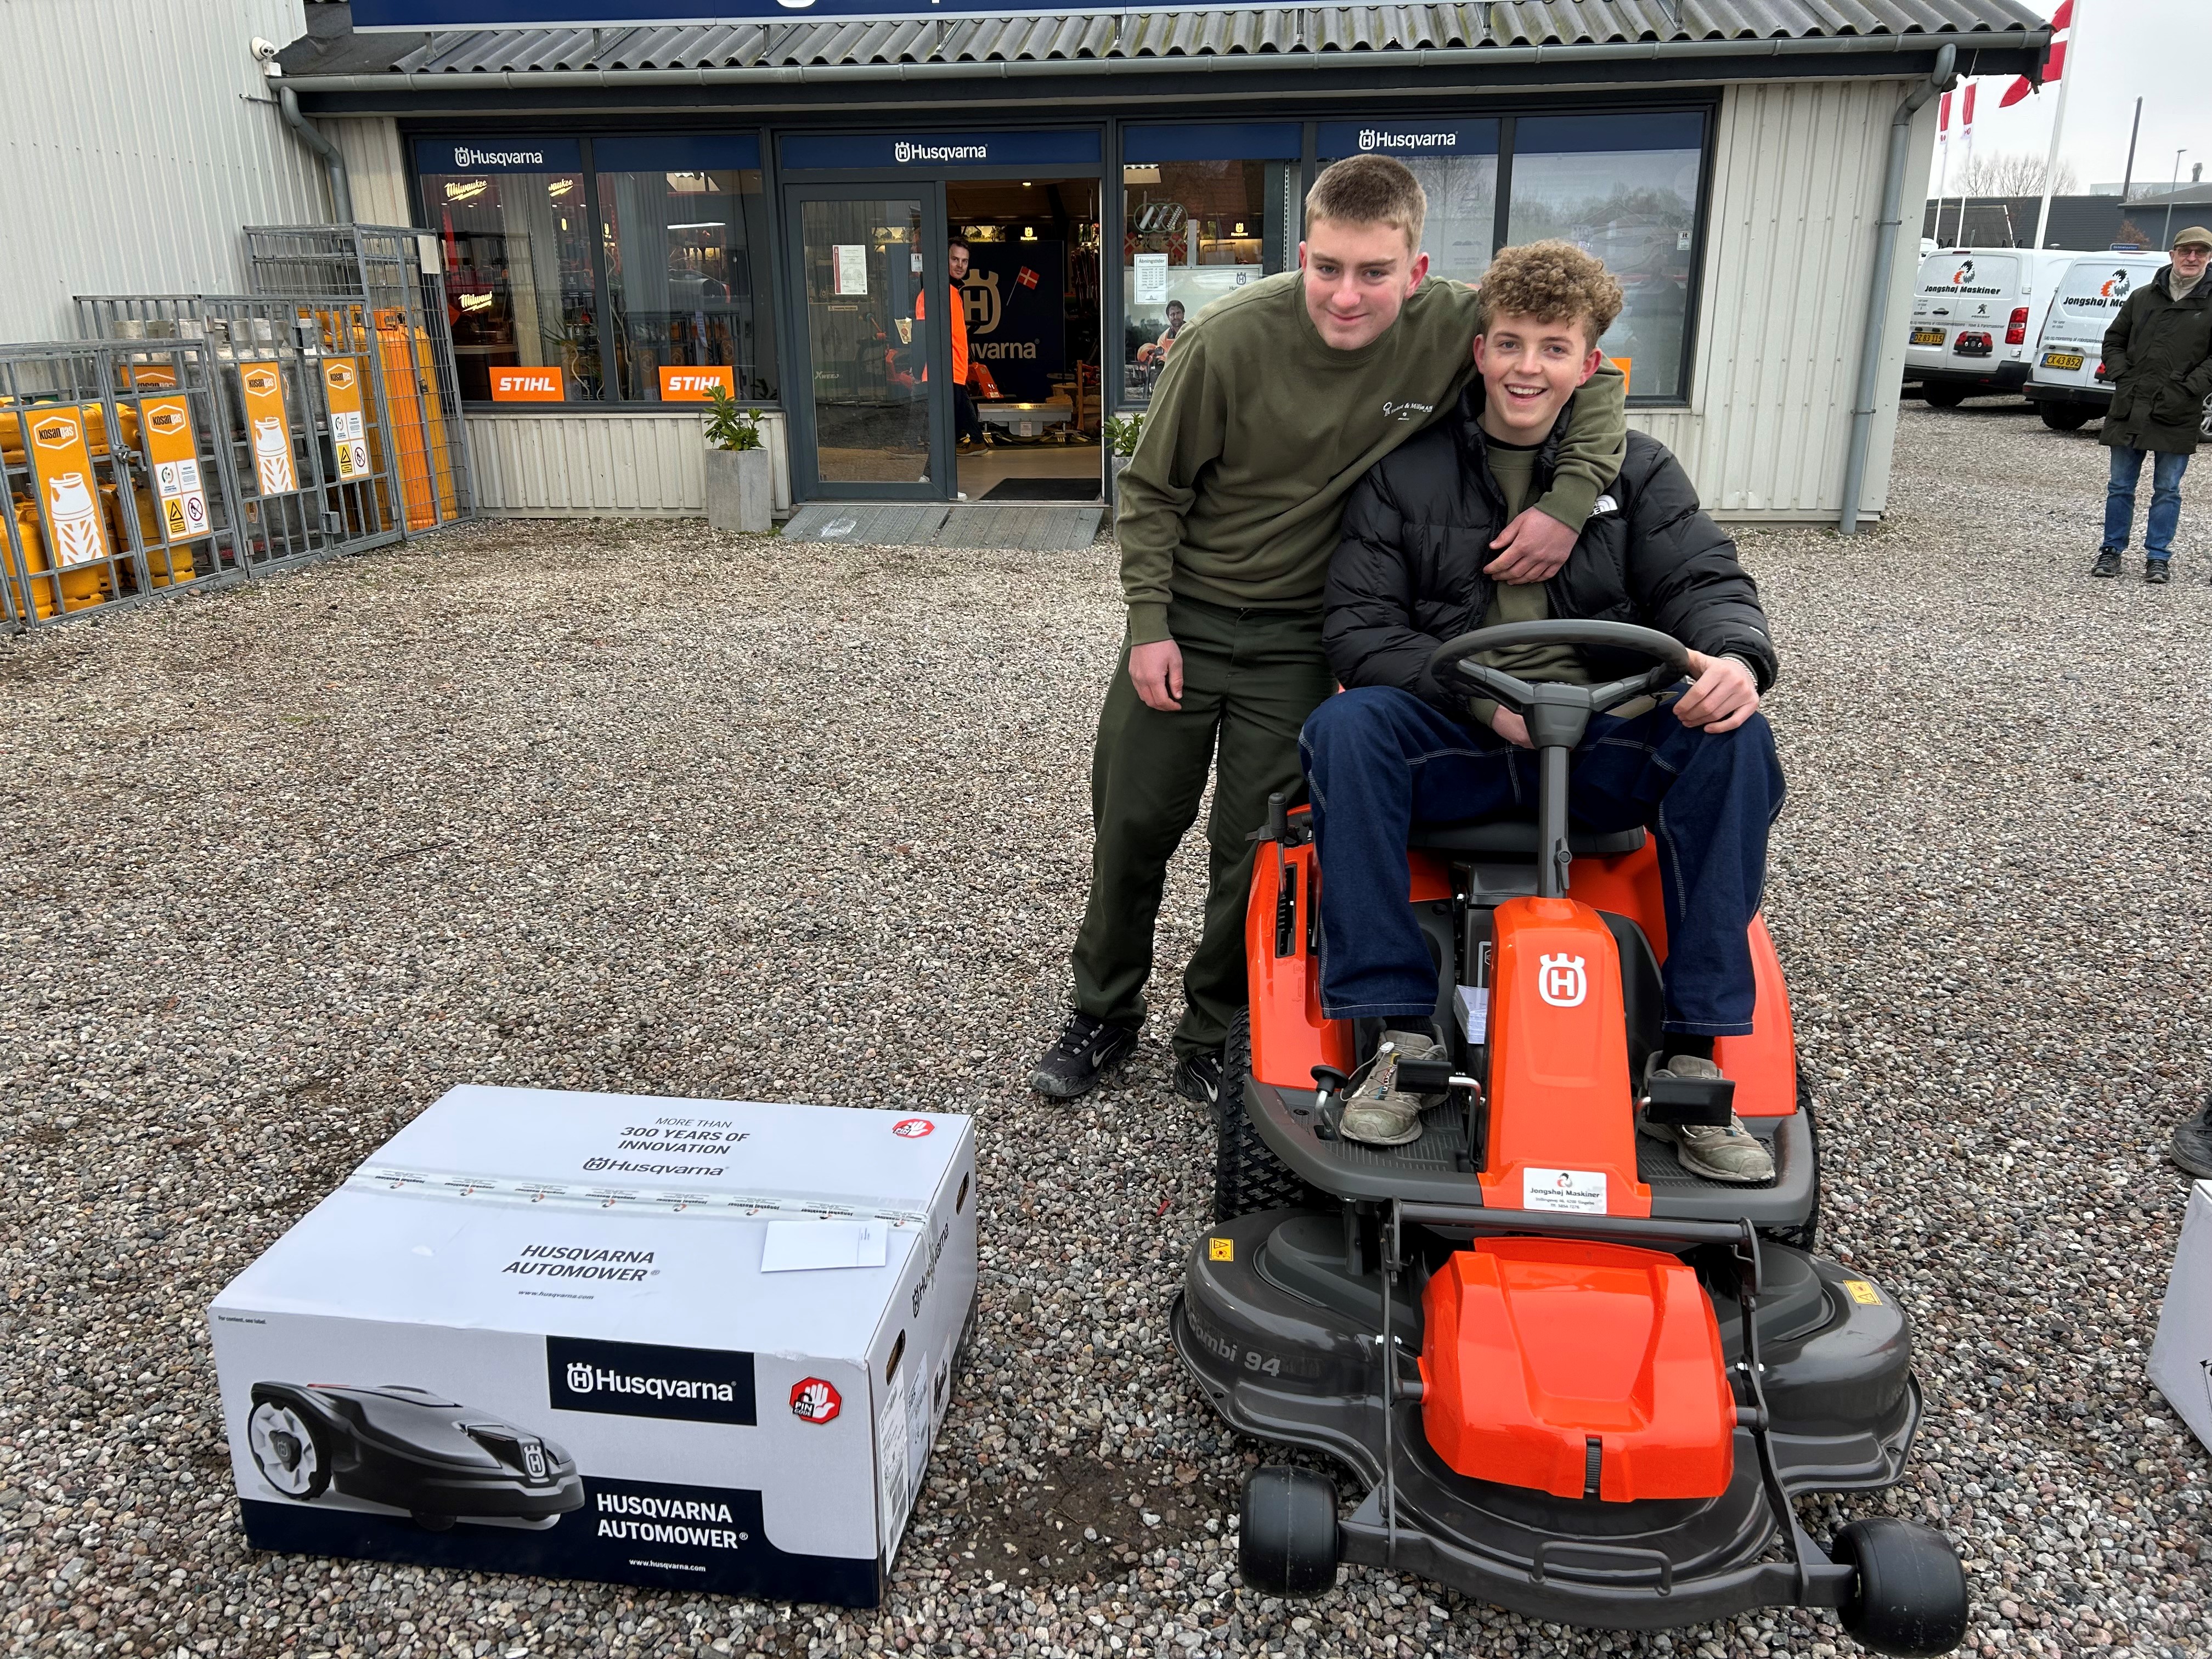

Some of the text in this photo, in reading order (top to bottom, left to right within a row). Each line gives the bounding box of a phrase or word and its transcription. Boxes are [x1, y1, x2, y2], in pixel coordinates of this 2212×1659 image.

[1925, 285, 2001, 295] Jongshøj Maskiner
[2063, 296, 2107, 308] Jongshøj
[2046, 356, 2080, 366] CX 43 852
[499, 377, 556, 392] STIHL
[655, 1118, 732, 1128] MORE THAN
[620, 1127, 751, 1142] 300 YEARS OF
[618, 1140, 732, 1154] INNOVATION
[521, 1245, 654, 1263] HUSQVARNA
[518, 1290, 594, 1300] www.husqvarna.com
[1244, 1351, 1281, 1377] 94
[795, 1401, 812, 1412] PIN
[597, 1493, 733, 1523] HUSQVARNA
[629, 1559, 706, 1572] www.husqvarna.com
